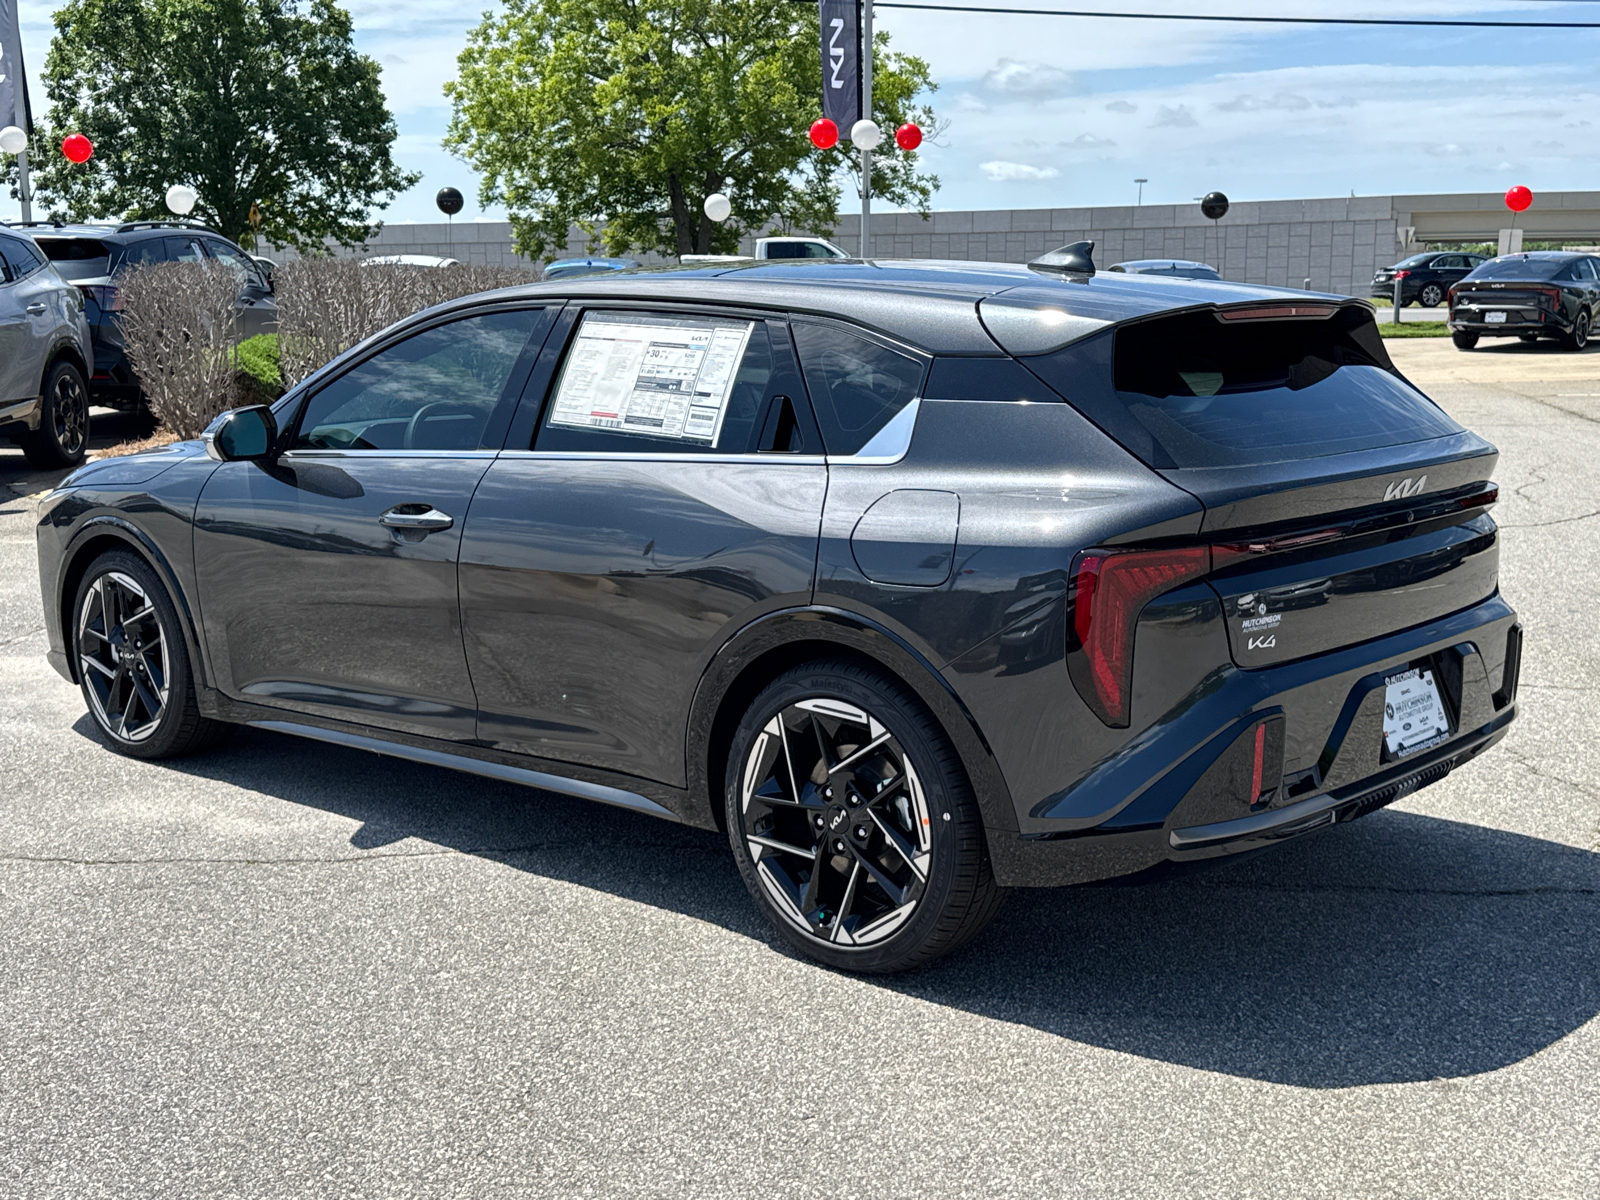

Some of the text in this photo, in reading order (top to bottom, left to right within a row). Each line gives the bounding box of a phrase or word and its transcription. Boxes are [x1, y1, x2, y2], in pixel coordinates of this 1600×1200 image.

[650, 349, 660, 358] 30
[1242, 614, 1281, 628] HUTCHINSON
[1248, 635, 1276, 650] K4
[1395, 692, 1433, 714] HUTCHINSON
